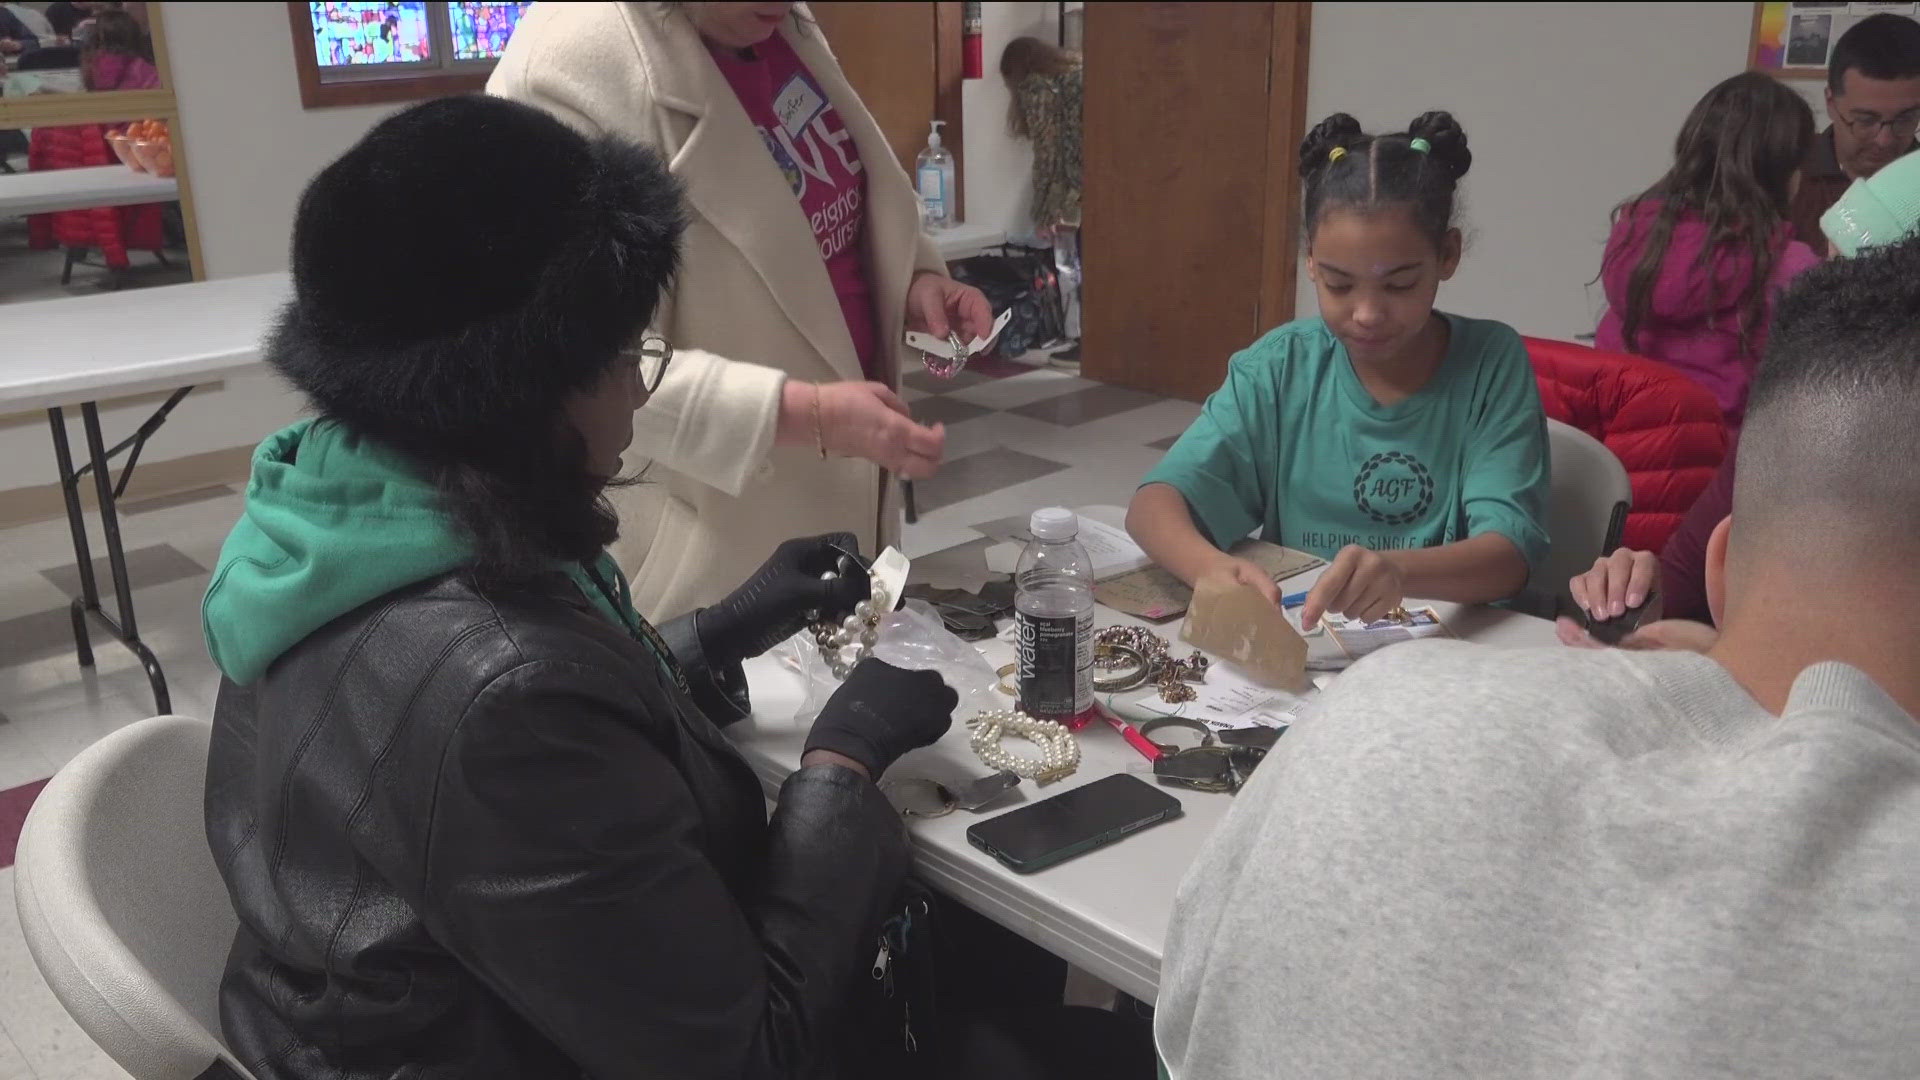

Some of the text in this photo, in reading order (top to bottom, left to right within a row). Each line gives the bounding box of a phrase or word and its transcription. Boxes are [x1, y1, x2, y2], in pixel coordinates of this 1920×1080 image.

[1369, 478, 1416, 503] AGF
[1367, 535, 1417, 551] SINGLE
[1022, 616, 1036, 679] water
